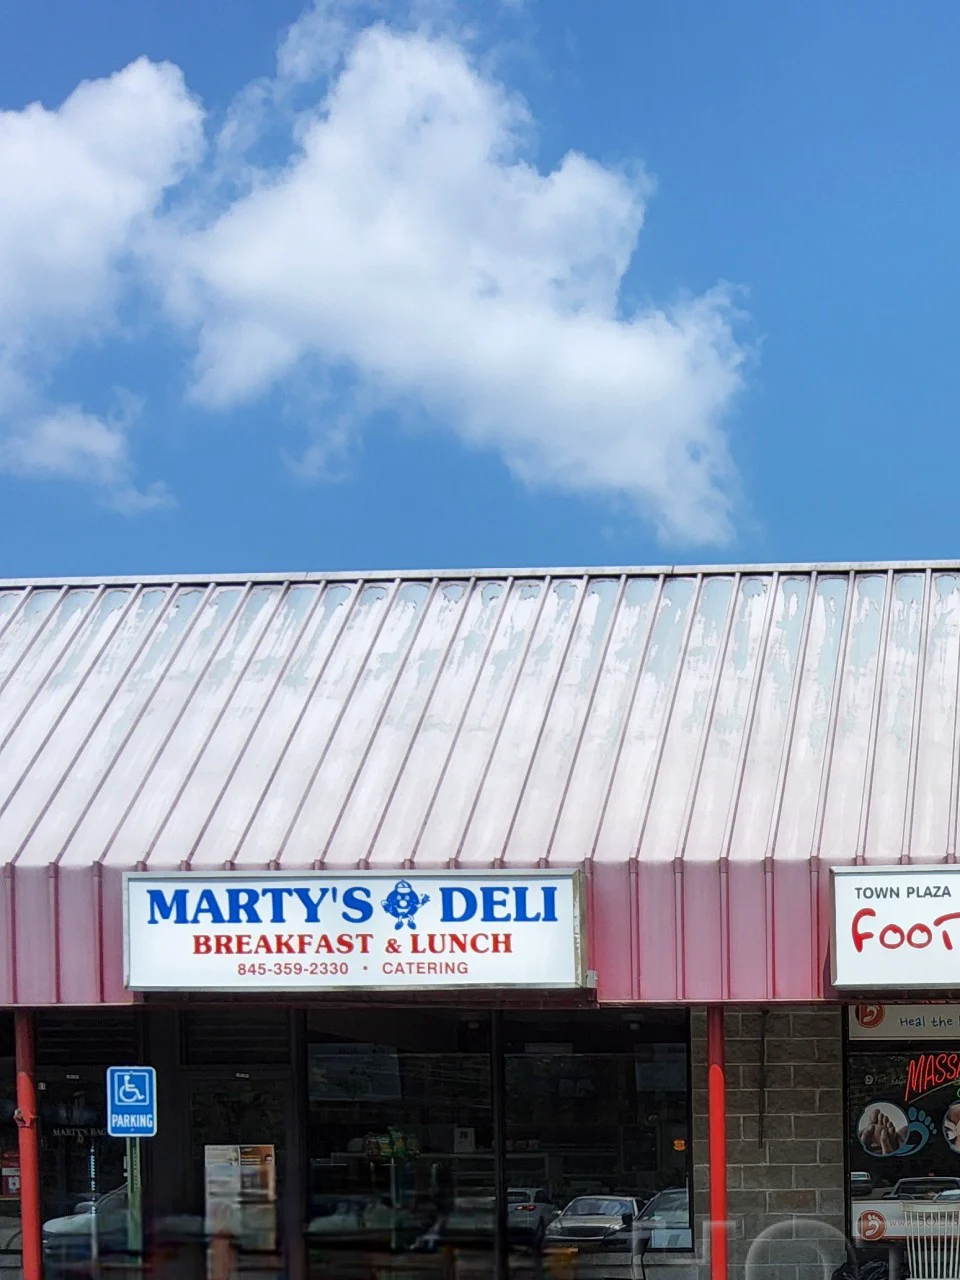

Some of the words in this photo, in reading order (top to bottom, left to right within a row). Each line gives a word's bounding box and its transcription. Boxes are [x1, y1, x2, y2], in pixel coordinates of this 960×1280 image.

[855, 887, 900, 899] TOWN
[906, 886, 952, 898] PLAZA
[146, 887, 373, 924] MARTY'S
[439, 887, 558, 922] DELI
[192, 934, 374, 954] BREAKFAST
[385, 938, 401, 954] &
[410, 933, 513, 954] LUNCH
[237, 962, 348, 976] 845-359-2330
[382, 961, 469, 975] CATERING
[900, 1016, 926, 1028] Heal
[931, 1017, 953, 1027] the
[111, 1114, 153, 1128] PARKING
